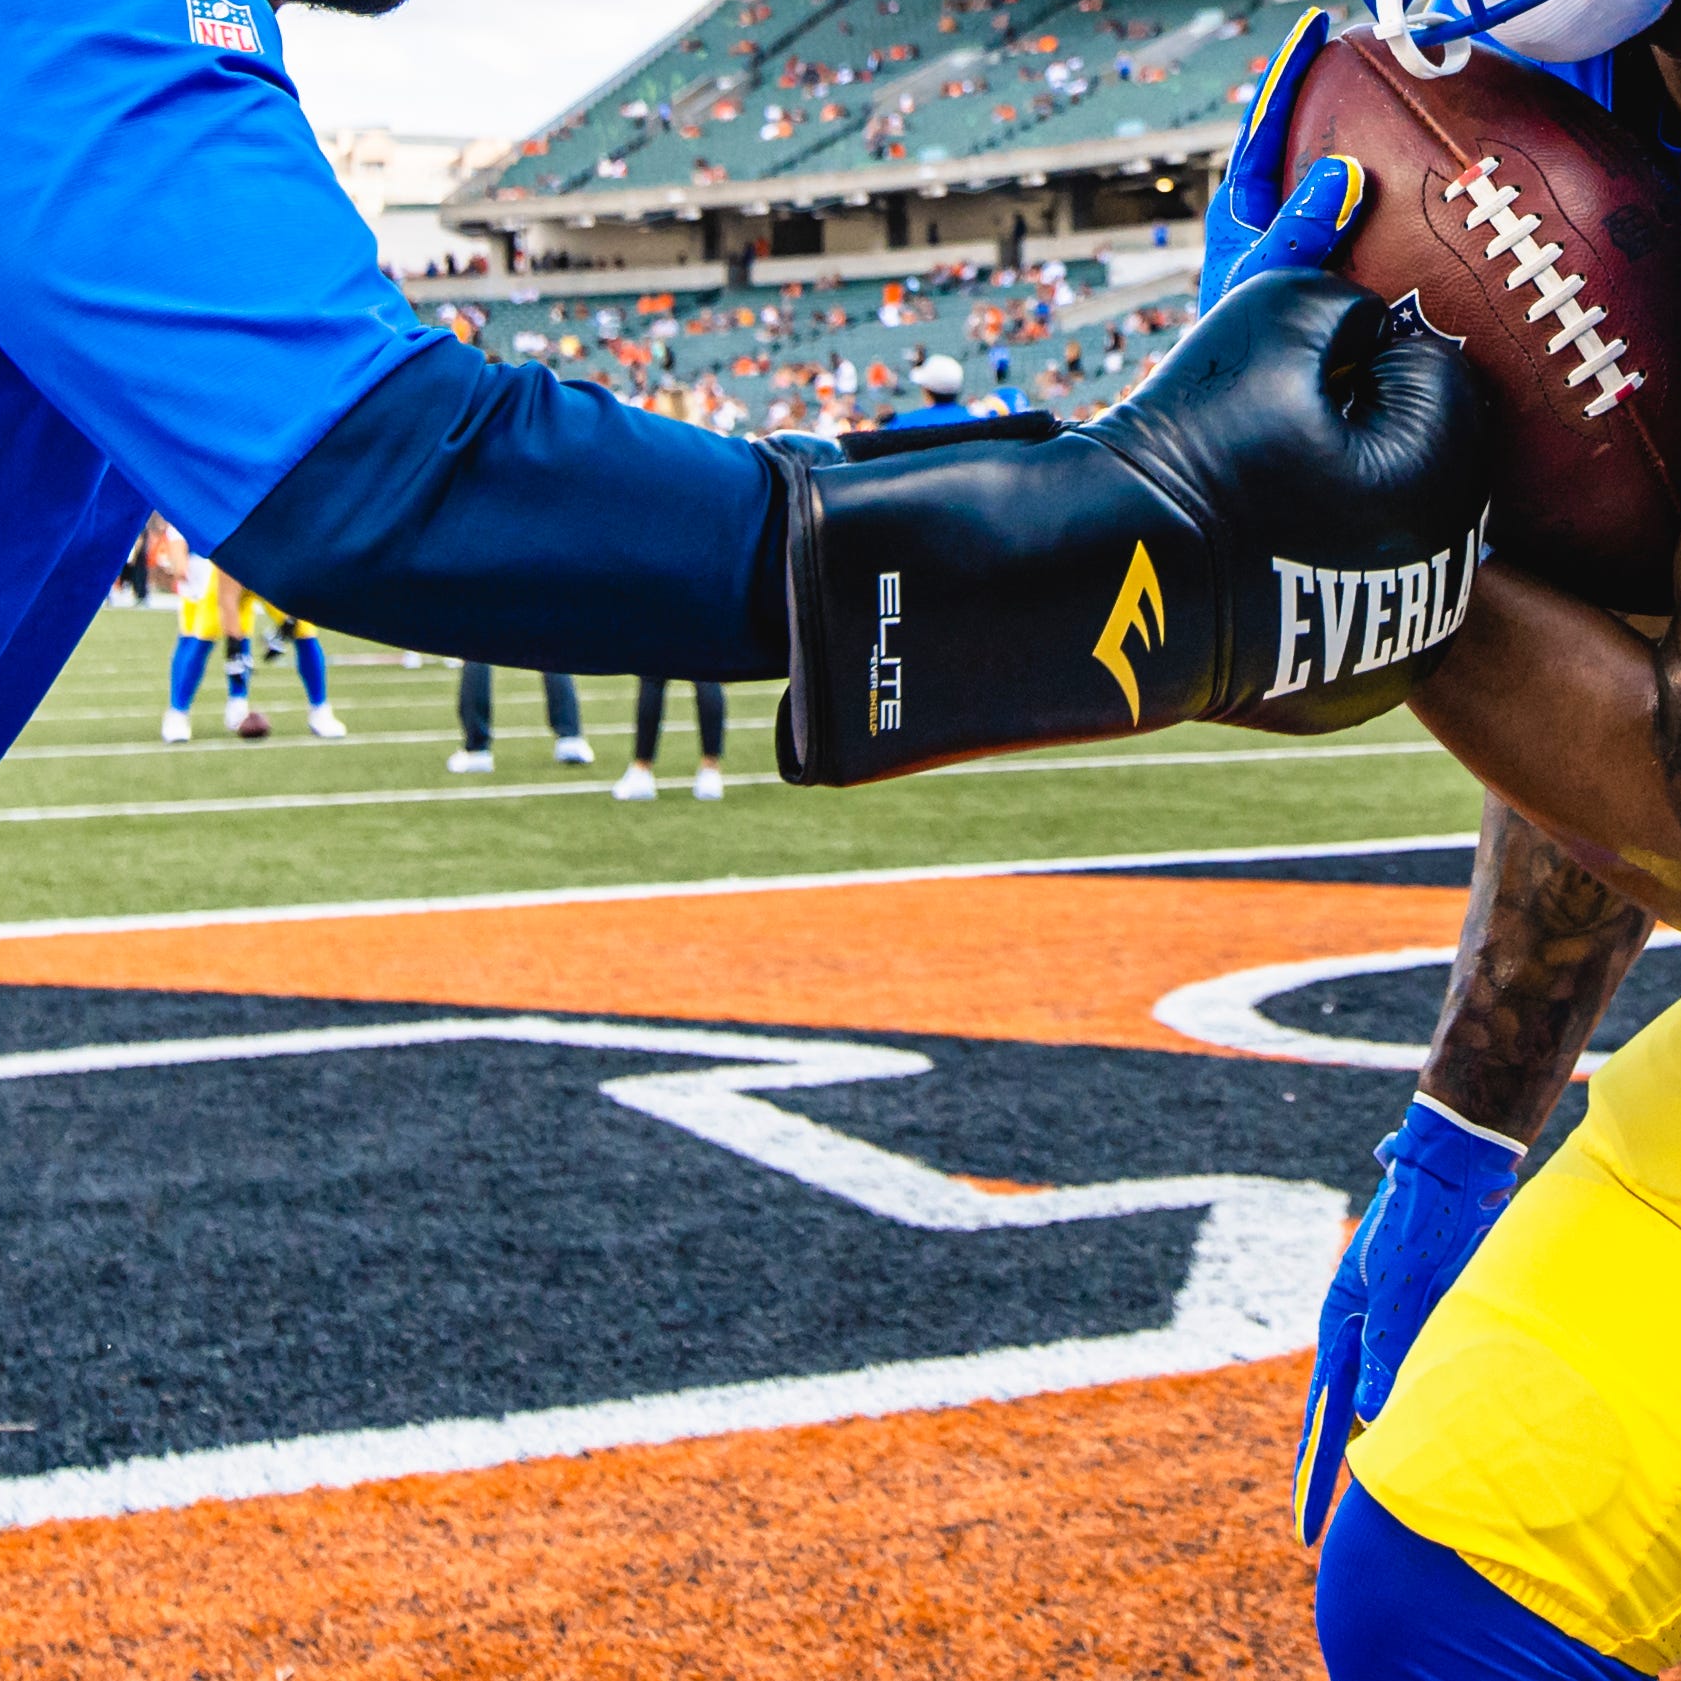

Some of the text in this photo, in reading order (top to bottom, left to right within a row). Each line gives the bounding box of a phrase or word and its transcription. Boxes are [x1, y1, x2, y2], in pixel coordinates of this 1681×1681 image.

[198, 21, 255, 51] NFL
[879, 571, 901, 731] ELITE
[1262, 498, 1491, 701] EVERLA
